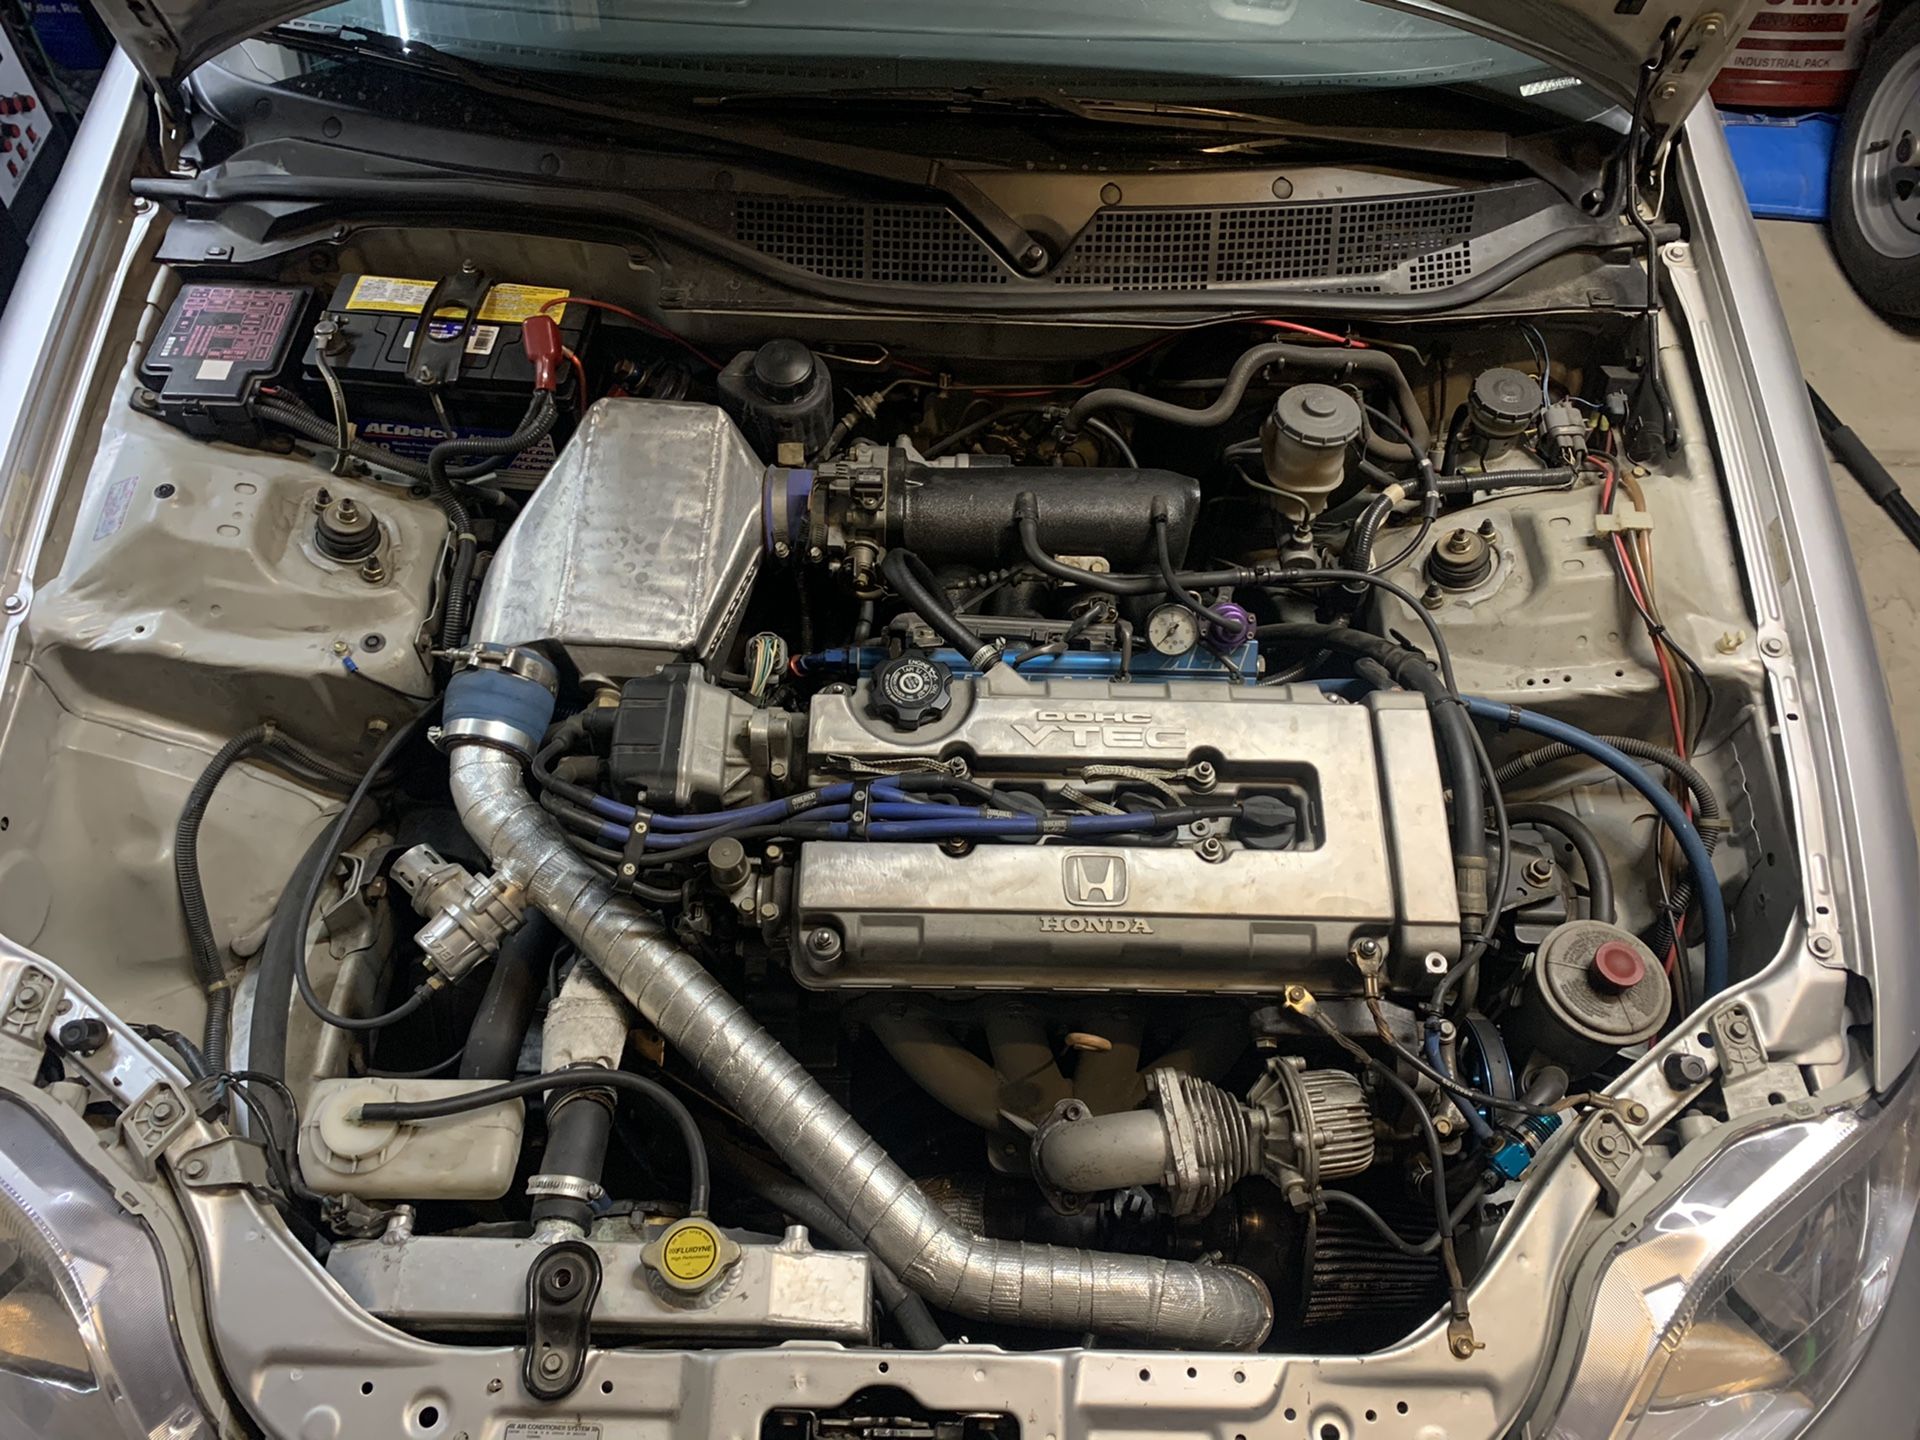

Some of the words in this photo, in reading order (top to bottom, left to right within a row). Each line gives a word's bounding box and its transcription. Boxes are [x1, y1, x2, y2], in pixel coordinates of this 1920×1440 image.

[1734, 56, 1800, 68] INDUSTRIAL
[1803, 58, 1832, 68] PACK
[1036, 710, 1152, 724] DOHC
[1010, 724, 1188, 749] VTEC
[1039, 916, 1154, 934] HONDA
